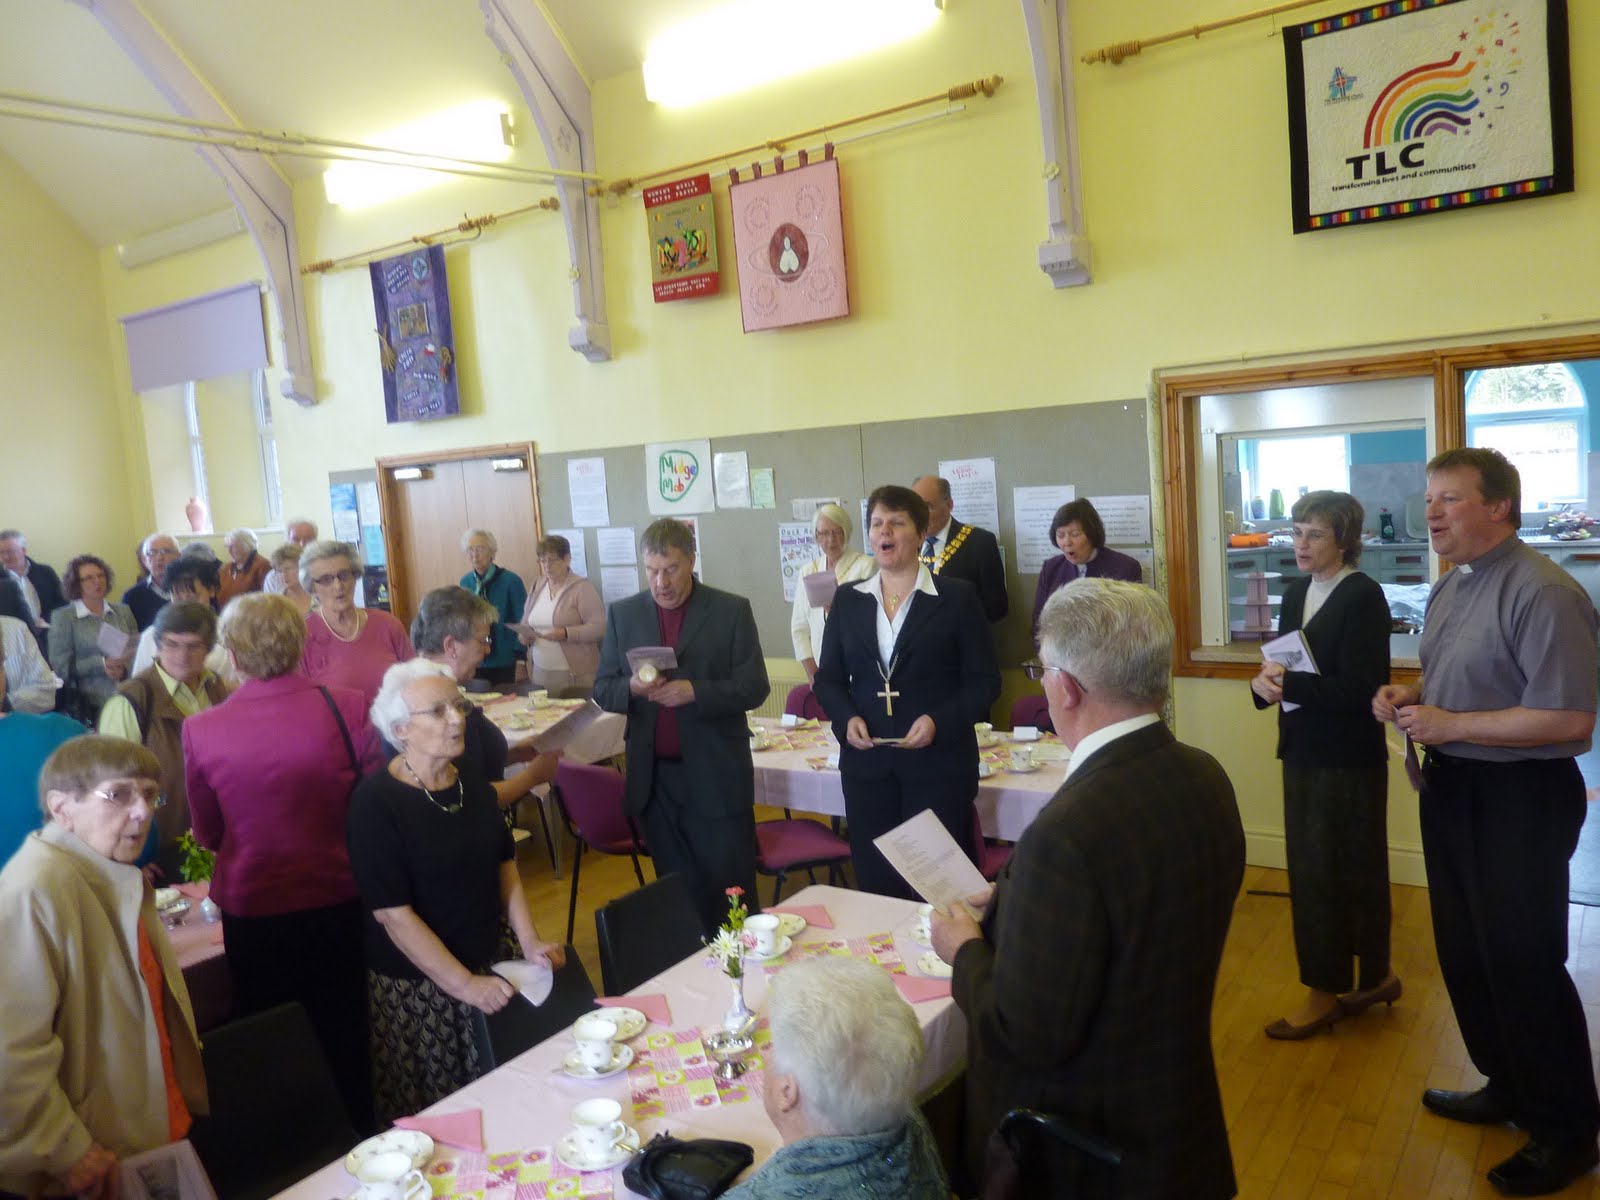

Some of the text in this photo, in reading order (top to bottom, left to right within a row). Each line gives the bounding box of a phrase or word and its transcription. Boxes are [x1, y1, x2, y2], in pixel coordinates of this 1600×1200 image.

[1345, 142, 1425, 180] TLC
[1332, 162, 1477, 192] transforming lives and communities
[661, 456, 696, 480] Midge
[663, 478, 684, 493] Mob
